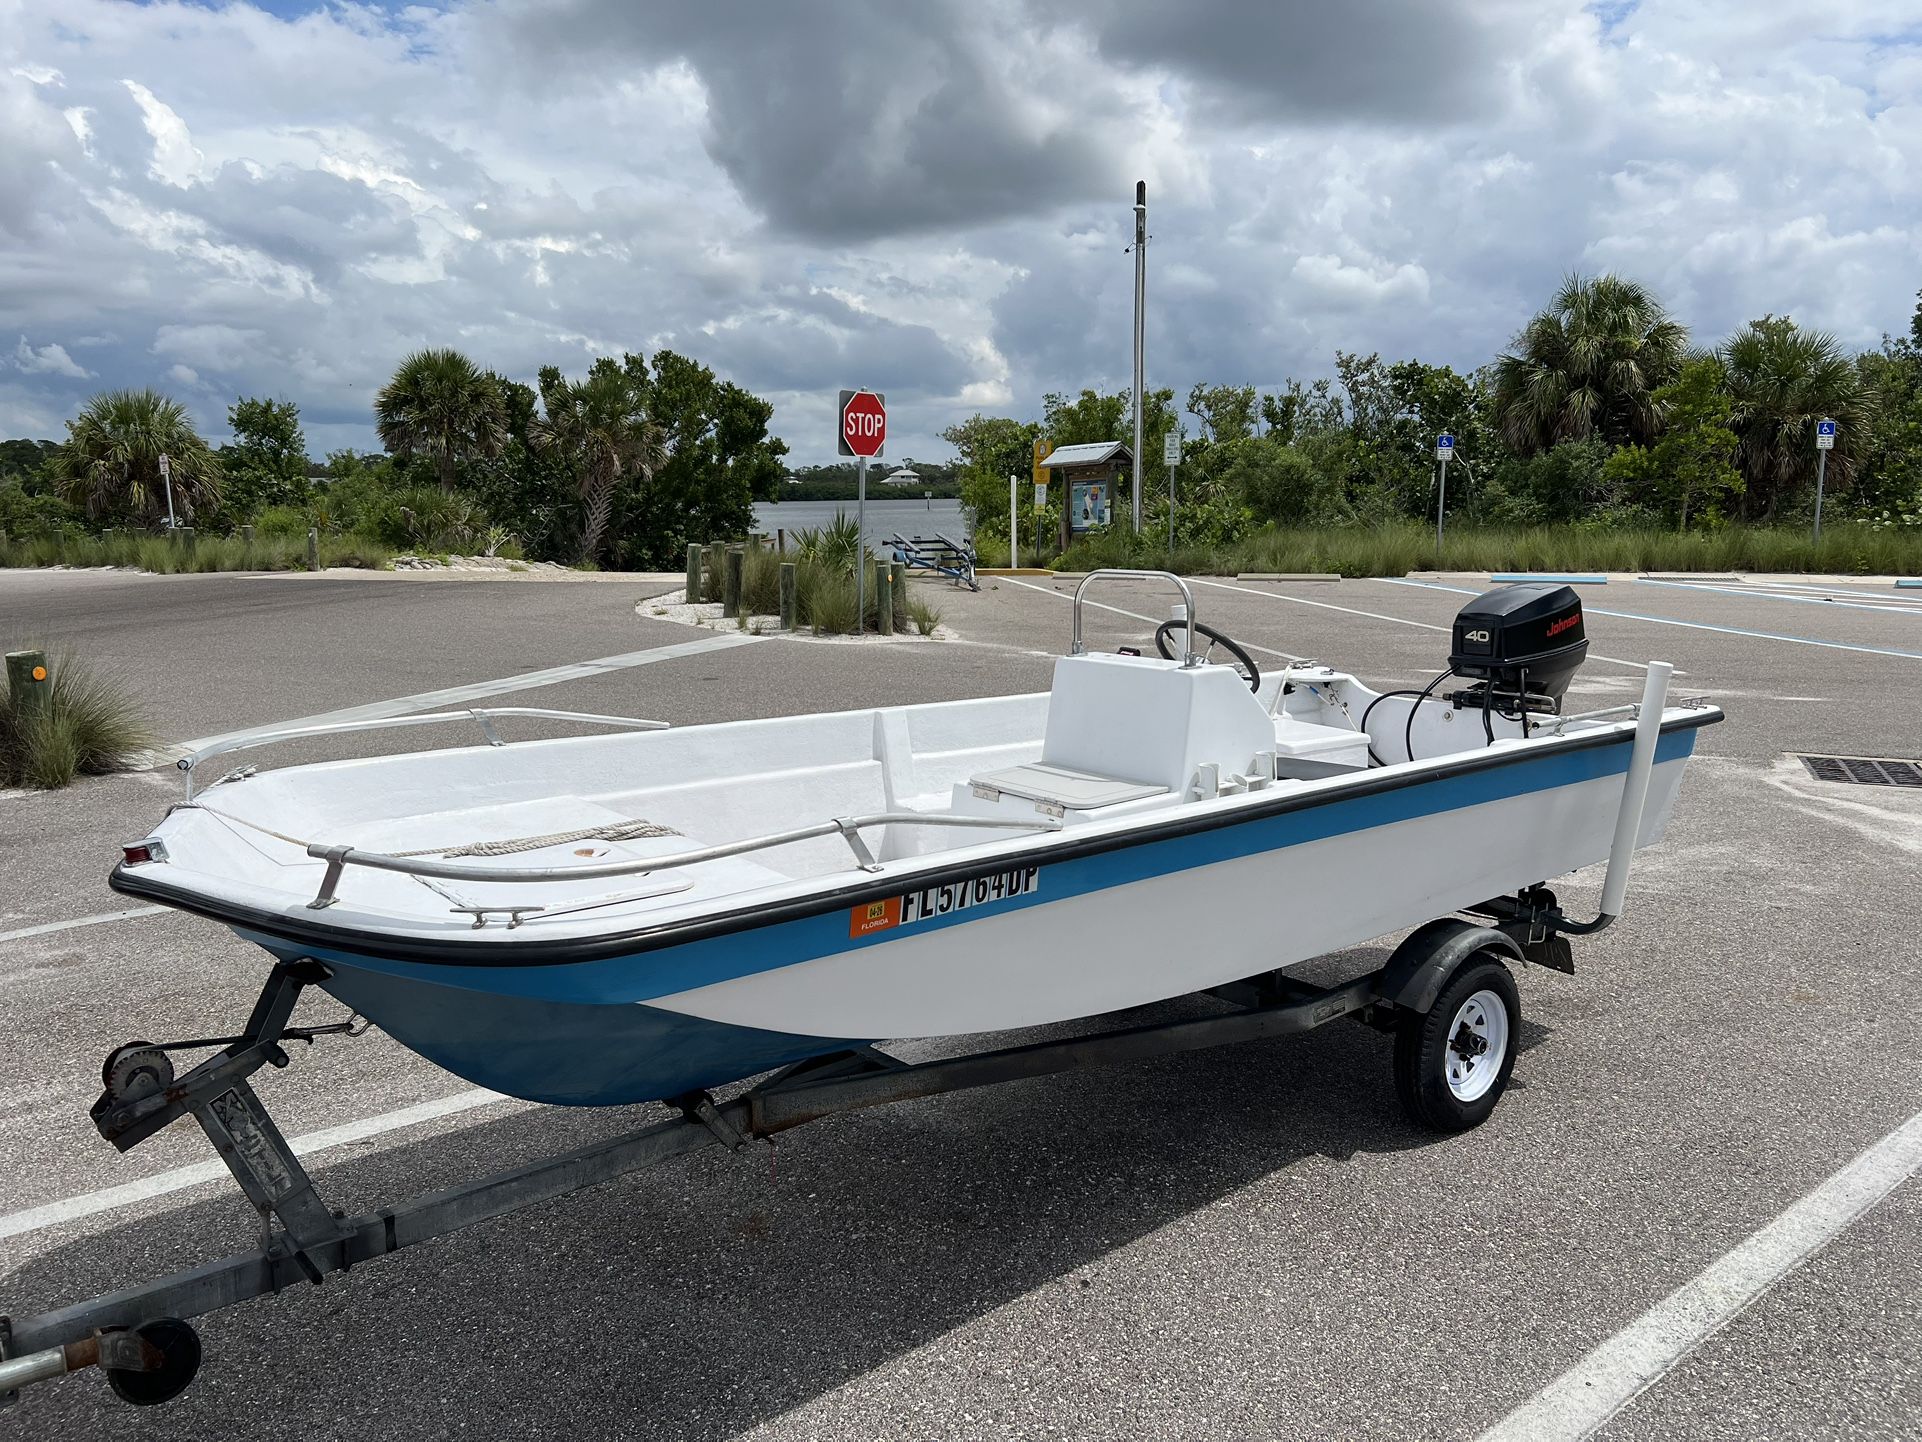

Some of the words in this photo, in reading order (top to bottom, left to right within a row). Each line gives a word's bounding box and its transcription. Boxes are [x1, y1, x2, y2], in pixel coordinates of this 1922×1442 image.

[847, 412, 884, 437] STOP
[1546, 613, 1580, 637] Johnson
[1465, 630, 1489, 643] 40
[861, 918, 889, 931] FLORIDA
